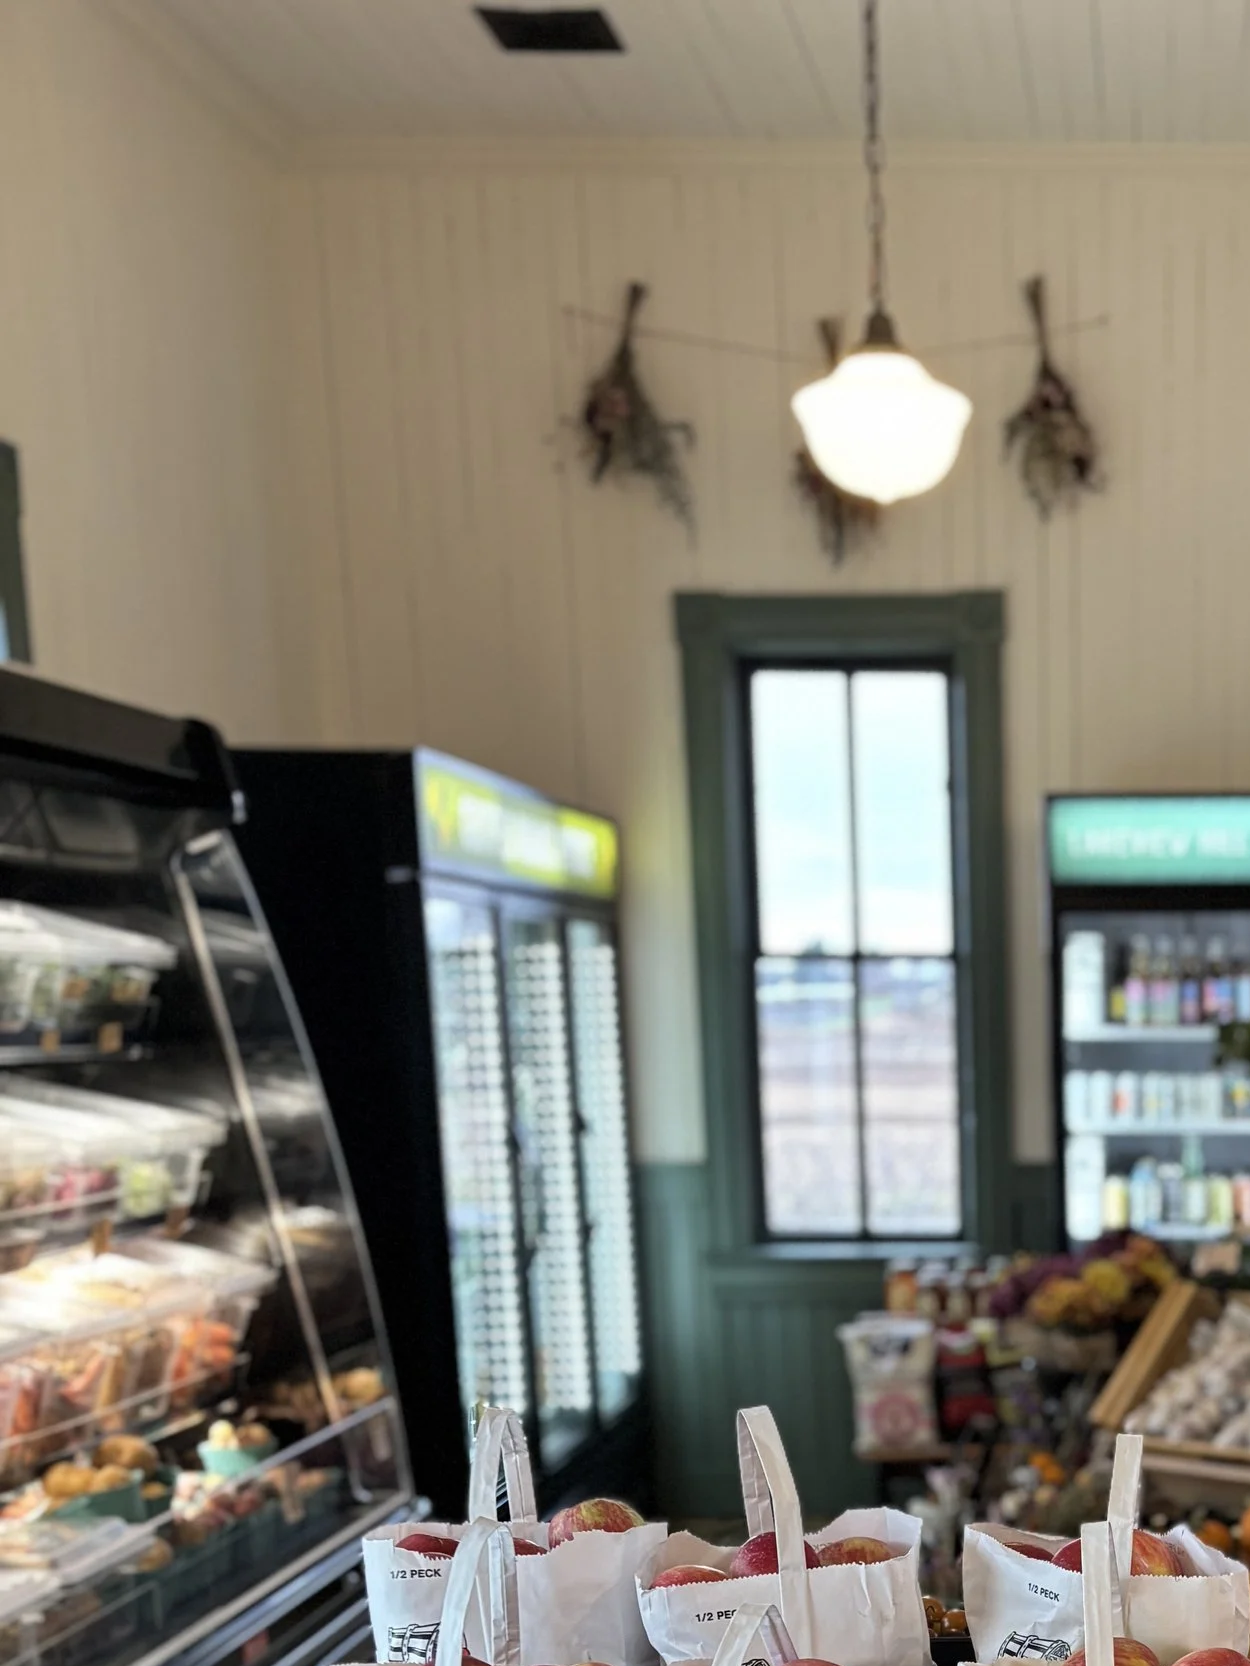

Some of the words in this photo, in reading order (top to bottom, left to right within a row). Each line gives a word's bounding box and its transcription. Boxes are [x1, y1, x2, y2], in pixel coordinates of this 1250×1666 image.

[390, 1570, 407, 1579] 1/2
[410, 1568, 442, 1579] PECK
[1028, 1583, 1038, 1594] 1/2
[1040, 1587, 1060, 1602] PECK
[695, 1612, 714, 1622] 1/2
[717, 1609, 737, 1620] PEC
